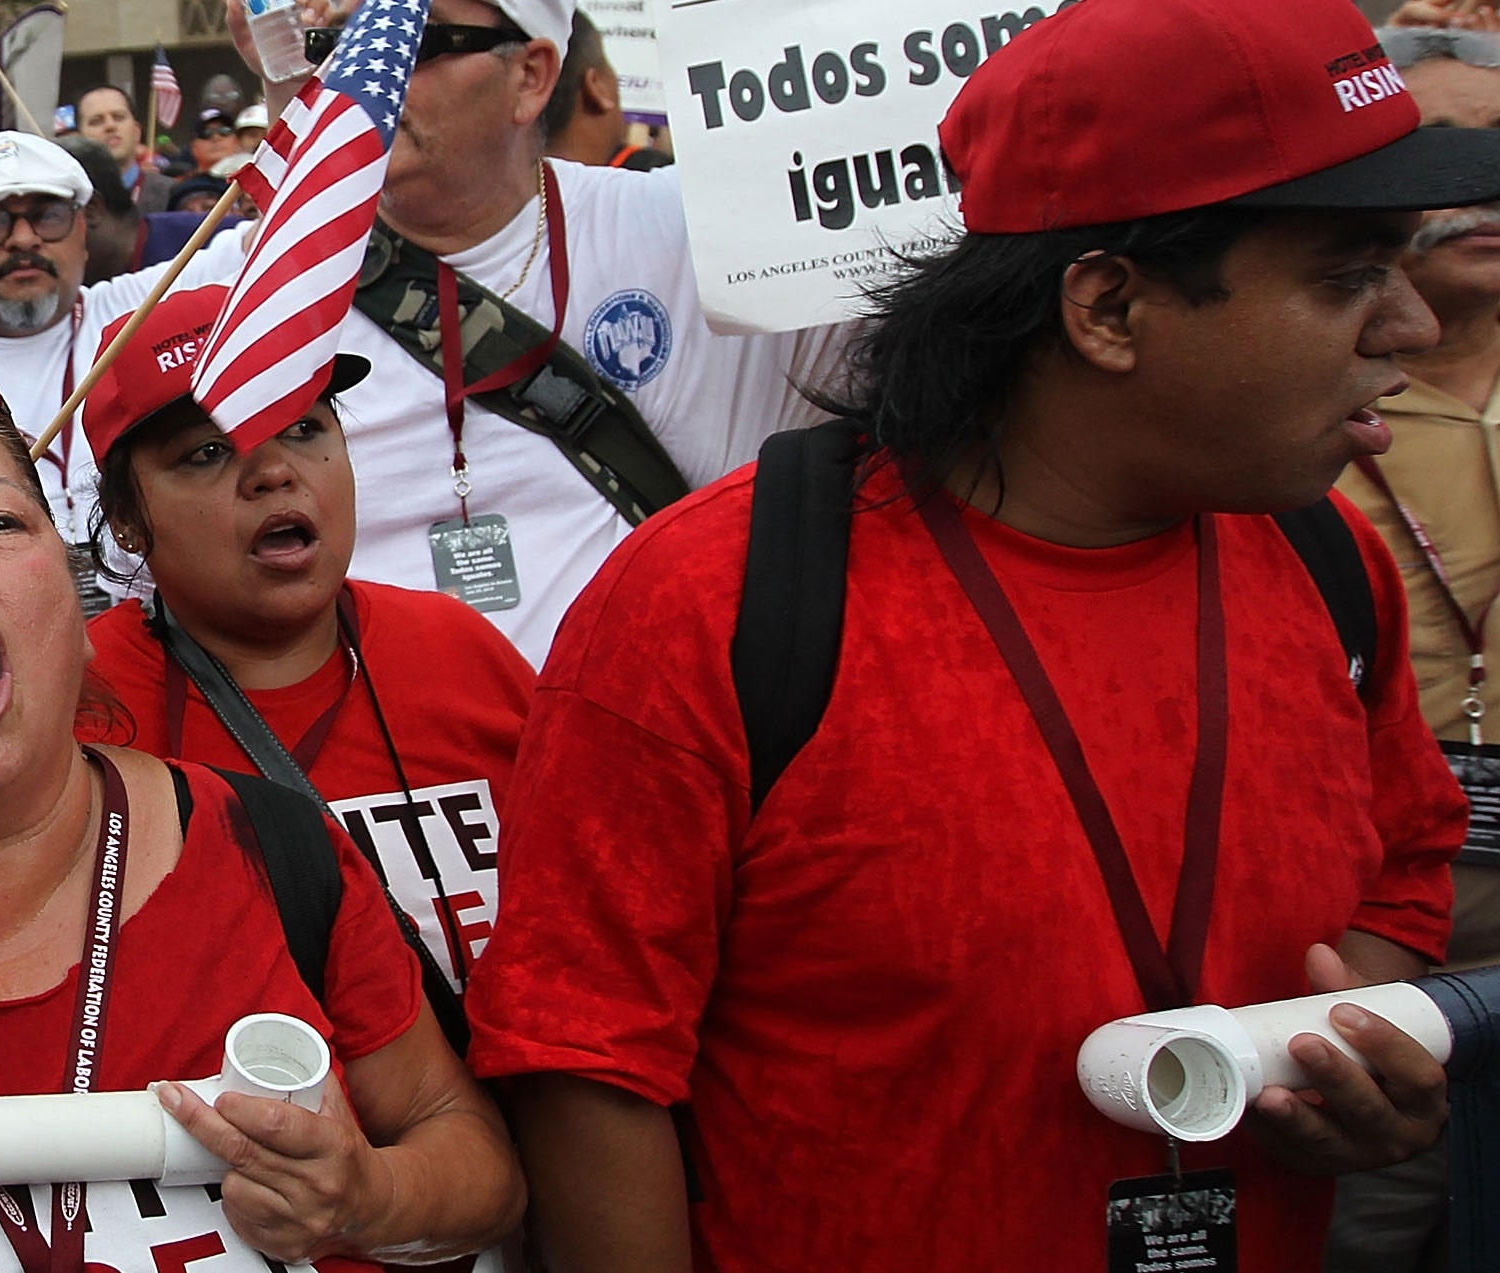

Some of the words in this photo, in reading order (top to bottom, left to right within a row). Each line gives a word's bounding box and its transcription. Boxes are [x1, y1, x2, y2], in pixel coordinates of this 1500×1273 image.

[617, 74, 649, 89] EIU
[687, 42, 887, 130] Todos
[903, 0, 1082, 86] som
[1333, 63, 1407, 112] RISIN
[788, 142, 962, 230] igua
[727, 270, 756, 285] LOS
[760, 258, 829, 279] ANGELES
[109, 811, 122, 836] LOS
[342, 793, 498, 888] ITE
[101, 835, 121, 890] ANGELES
[94, 890, 114, 944] COUNTY
[83, 943, 108, 1027] FEDERATION
[80, 1028, 97, 1048] OF
